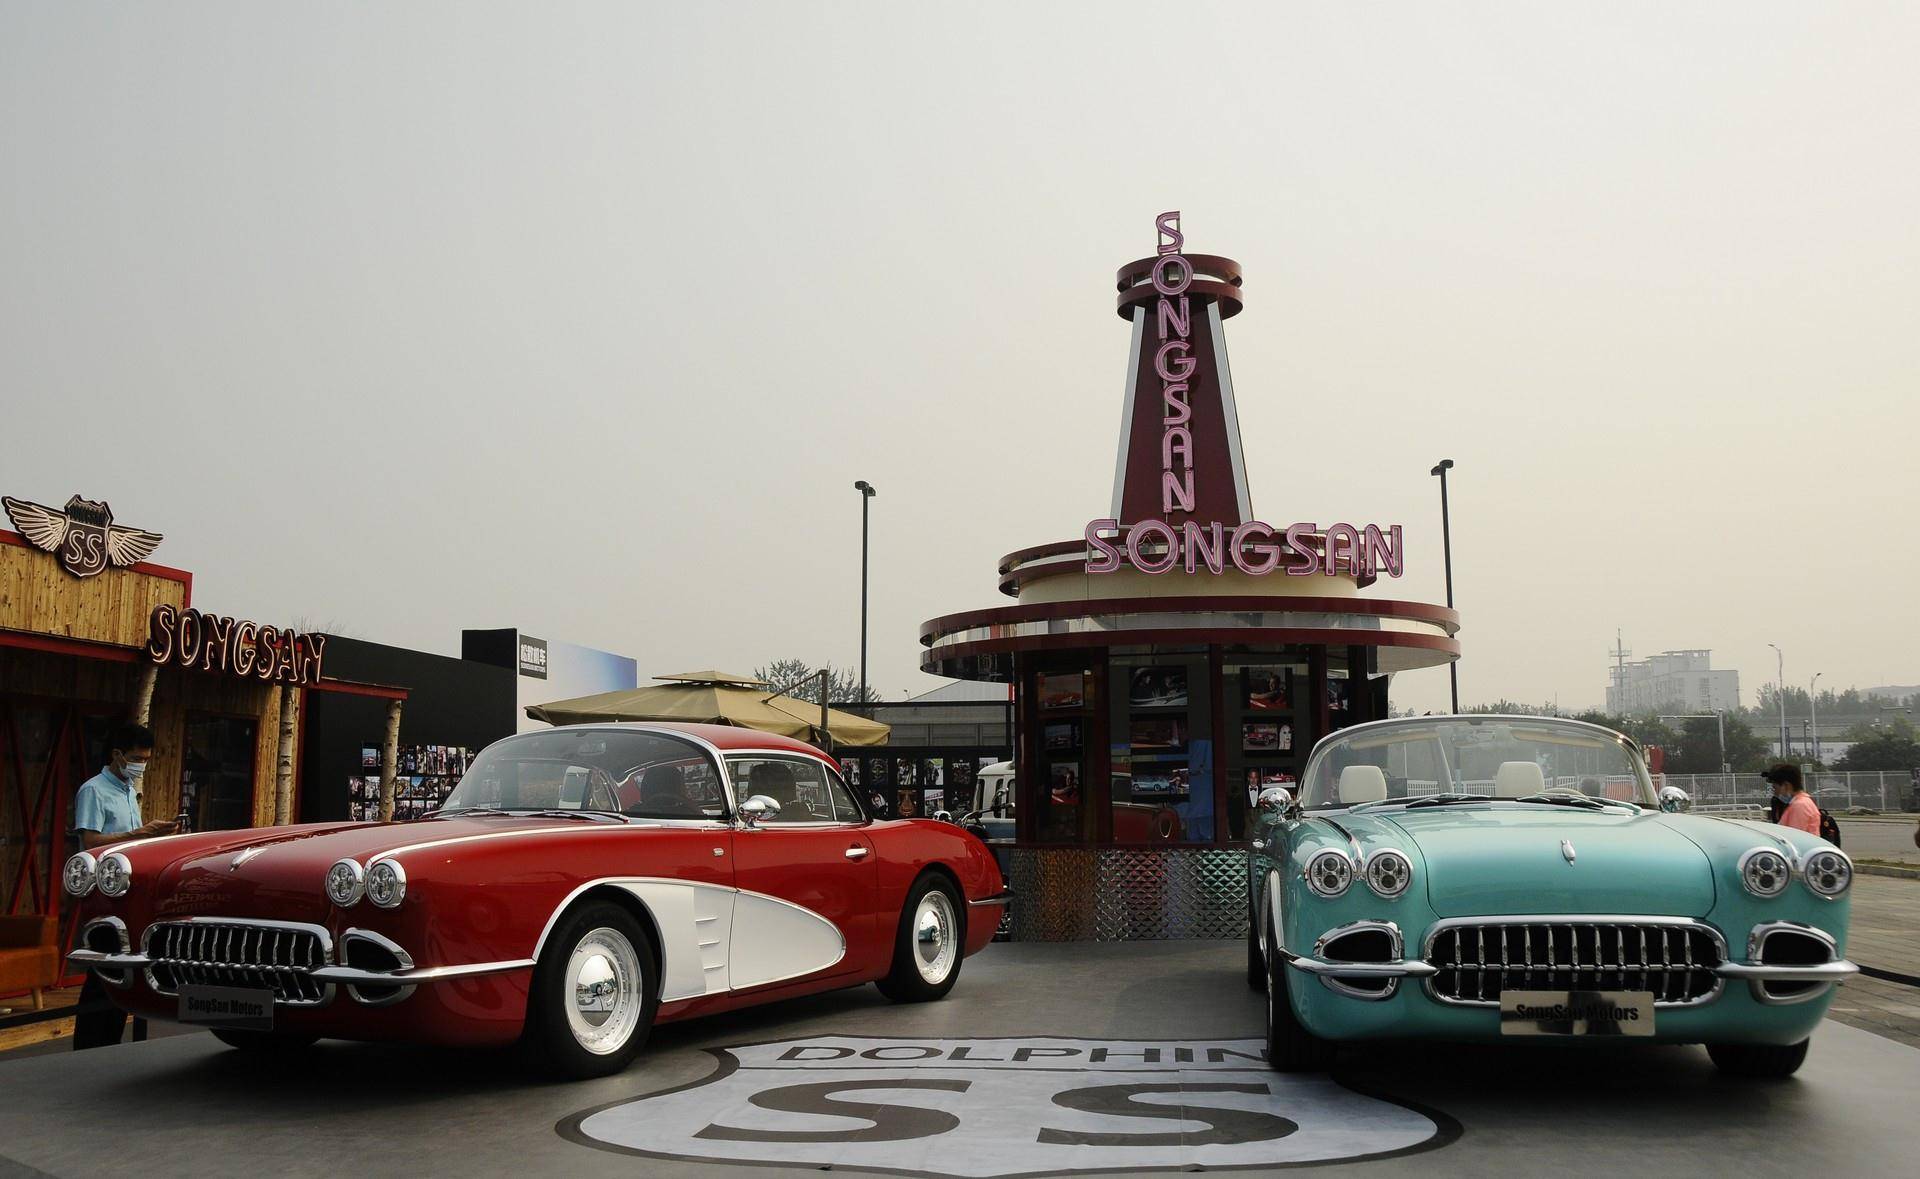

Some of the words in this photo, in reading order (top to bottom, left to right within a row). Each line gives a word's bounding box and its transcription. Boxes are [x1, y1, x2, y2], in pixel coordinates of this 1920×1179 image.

[1152, 210, 1197, 513] SONGSAN
[65, 529, 103, 568] SS
[1085, 518, 1404, 579] SONGSAN
[150, 603, 326, 685] SONGSAN
[1516, 1004, 1584, 1022] SongSan
[1587, 1005, 1639, 1021] Motors
[776, 1046, 1273, 1063] DOLPHIN
